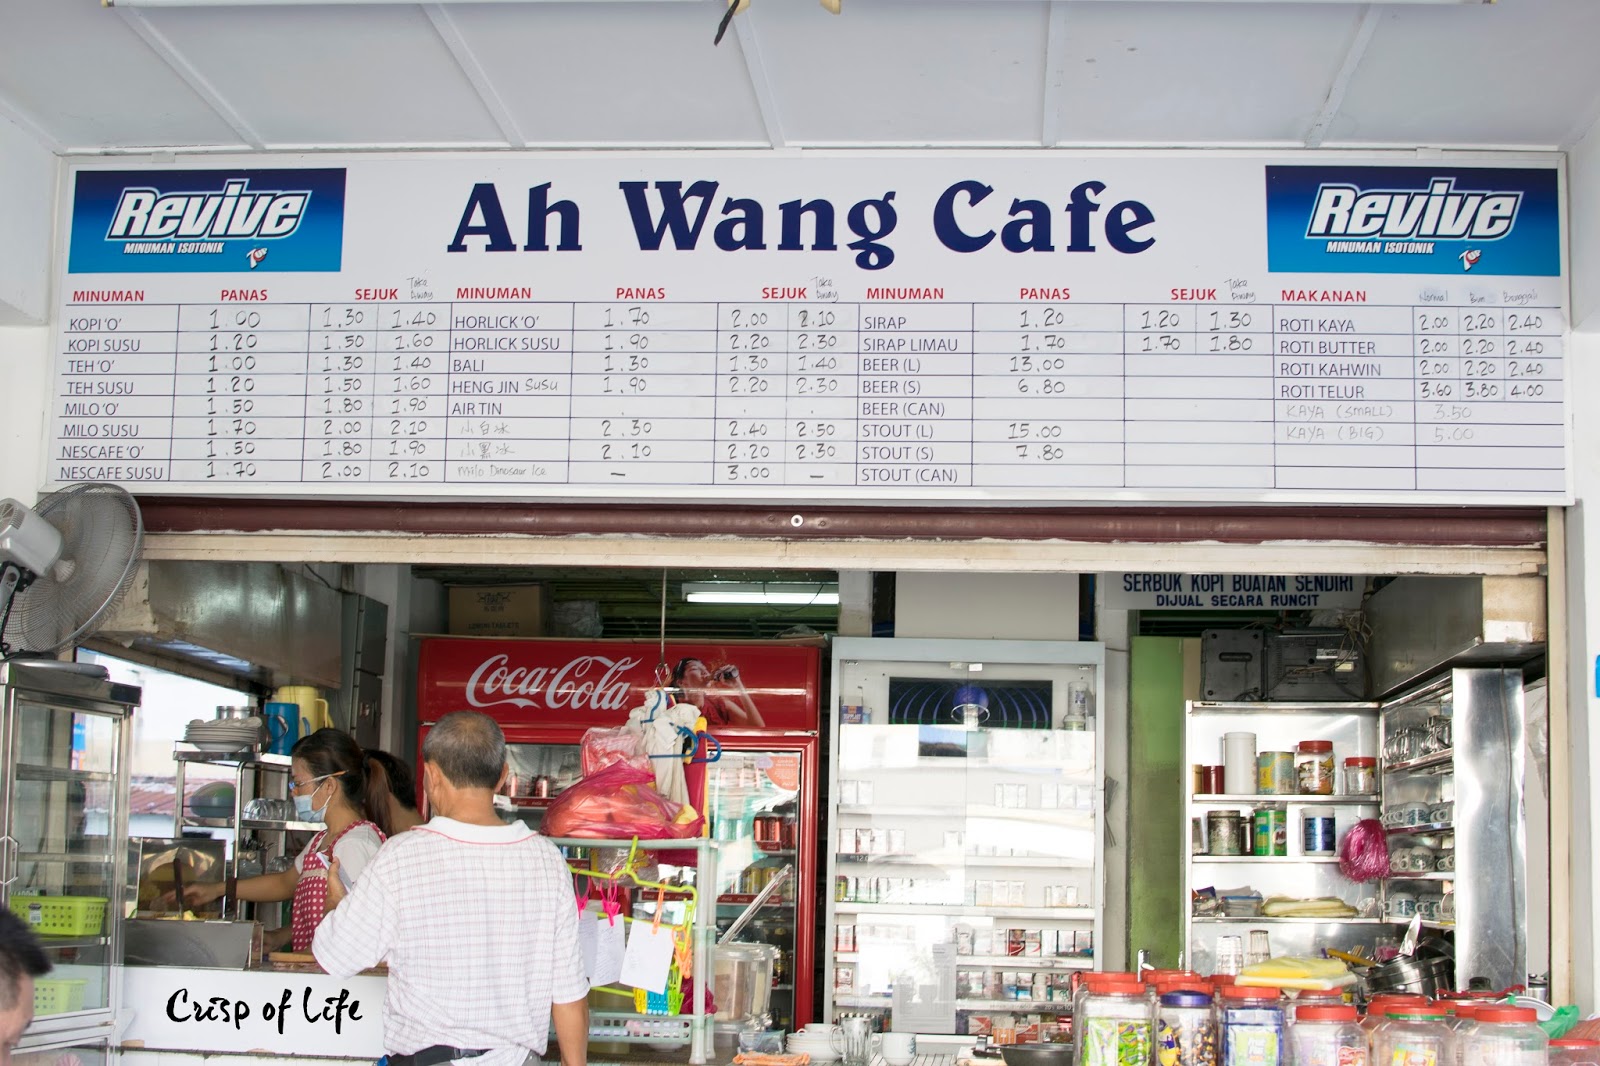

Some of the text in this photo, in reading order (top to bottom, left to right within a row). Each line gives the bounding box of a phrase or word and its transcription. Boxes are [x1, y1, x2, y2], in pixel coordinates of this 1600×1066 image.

[105, 178, 313, 241] Revive
[1304, 176, 1524, 241] Revive
[447, 180, 1156, 270] Ah Wang Cafe
[124, 242, 225, 254] MINUMAN ISOTONIK
[1326, 241, 1435, 254] MINUMAN ISOTONIK
[73, 291, 144, 302] MINUMAN
[221, 290, 267, 300] PANAS
[356, 289, 398, 300] SEJUK
[457, 288, 530, 299] MINUMAN
[617, 288, 665, 299] PANAS
[763, 288, 806, 299] SEJUK
[867, 288, 943, 299] MINUMAN
[1021, 288, 1070, 299] PANAS
[1171, 289, 1216, 300] SEJUK
[1282, 290, 1365, 301] MAKANAN
[70, 319, 101, 330] KOPI
[210, 309, 260, 329] 1.00
[324, 307, 363, 328] 1.30
[392, 310, 436, 328] 1.40
[456, 316, 517, 328] HORLICK
[604, 307, 649, 327] 1.70
[732, 309, 767, 328] 2.00
[865, 317, 906, 329] SIRAP
[1021, 308, 1063, 327] 1.20
[1142, 310, 1179, 329] 1.20
[1210, 311, 1251, 331] 1.30
[1420, 315, 1448, 330] 2.00
[1464, 314, 1494, 331] 2.20
[1509, 314, 1542, 330] 2.40
[1281, 319, 1354, 331] ROTI KAYA
[69, 339, 140, 351] KOPI SUSU
[211, 334, 257, 351] 1.20
[324, 335, 363, 350] 1.50
[395, 334, 433, 350] 1.60
[455, 338, 559, 350] HORLICK SUSU
[605, 334, 648, 350] 1.90
[730, 334, 769, 349] 2.20
[798, 334, 836, 349] 2.30
[864, 338, 957, 353] SIRAP LIMAU
[1022, 335, 1064, 351] 1.70
[1143, 336, 1180, 351] 1.70
[1210, 335, 1252, 351] 1.80
[1281, 341, 1375, 354] ROTI BUTTER
[1421, 339, 1447, 354] 2.00
[1463, 339, 1494, 354] 2.20
[1508, 340, 1543, 355] 2.40
[68, 360, 94, 372] TEH
[209, 355, 255, 372] 1.00
[323, 356, 362, 372] 1.30
[393, 356, 431, 371] 1.40
[454, 360, 484, 371] BALI
[605, 355, 648, 371] 1.30
[730, 355, 767, 372] 1.30
[799, 355, 836, 371] 1.40
[864, 359, 920, 373] BEER (L)
[1010, 356, 1064, 372] 13.00
[1281, 363, 1380, 376] ROTI KAHWIN
[1420, 360, 1448, 375] 2.00
[1465, 360, 1495, 376] 2.20
[1509, 361, 1543, 377] 2.40
[67, 382, 133, 394] TEH SUSU
[207, 376, 254, 393] 1.20
[325, 377, 361, 393] 1.50
[394, 376, 430, 392] 1.60
[453, 381, 493, 393] HENG
[495, 381, 518, 395] JIN
[602, 378, 647, 394] 1.90
[730, 376, 767, 393] 2.20
[797, 377, 837, 394] 2.30
[863, 381, 920, 395] BEER (S)
[1018, 379, 1065, 394] 6.80
[1282, 385, 1364, 398] ROTI TELUR
[1421, 382, 1451, 398] 3.60
[1466, 382, 1497, 397] 3.80
[1511, 385, 1543, 396] 4.00
[65, 403, 99, 415] MILO
[208, 398, 253, 414] 1.50
[325, 398, 362, 414] 1.80
[392, 397, 427, 414] 1.90
[452, 403, 501, 415] AIR TIN
[863, 403, 944, 417] BEER (CAN)
[1434, 404, 1472, 420] 3.50
[1285, 405, 1326, 422] KAYA
[64, 425, 138, 437] MILO SUSU
[208, 419, 255, 435] 1.70
[324, 420, 361, 435] 2.00
[391, 420, 426, 435] 2.10
[602, 418, 654, 436] 2.30
[729, 421, 766, 436] 2.40
[797, 422, 834, 437] 2.50
[863, 425, 933, 439] STOUT (L)
[1008, 423, 1061, 439] 15.00
[1434, 427, 1473, 442] 5.00
[1285, 426, 1325, 444] KAYA
[62, 446, 123, 458] NESCAFE
[207, 440, 254, 457] 1.50
[323, 440, 361, 456] 1.80
[390, 440, 425, 455] 1.90
[602, 443, 651, 459] 2.10
[728, 444, 769, 459] 2.20
[796, 443, 834, 459] 2.30
[863, 447, 933, 461] STOUT (S)
[1016, 445, 1063, 460] 7.80
[61, 467, 162, 479] NESCAFE SUSU
[207, 462, 256, 478] 1.70
[322, 462, 361, 478] 2.00
[389, 462, 429, 478] 2.10
[728, 465, 769, 480] 3.00
[862, 469, 957, 483] STOUT (CAN)
[1123, 573, 1182, 592] SERBUK
[1191, 575, 1225, 592] KOPI
[1157, 594, 1319, 606] DIJUAL SECARA RUNCIT
[465, 653, 643, 711] Coca-Cola
